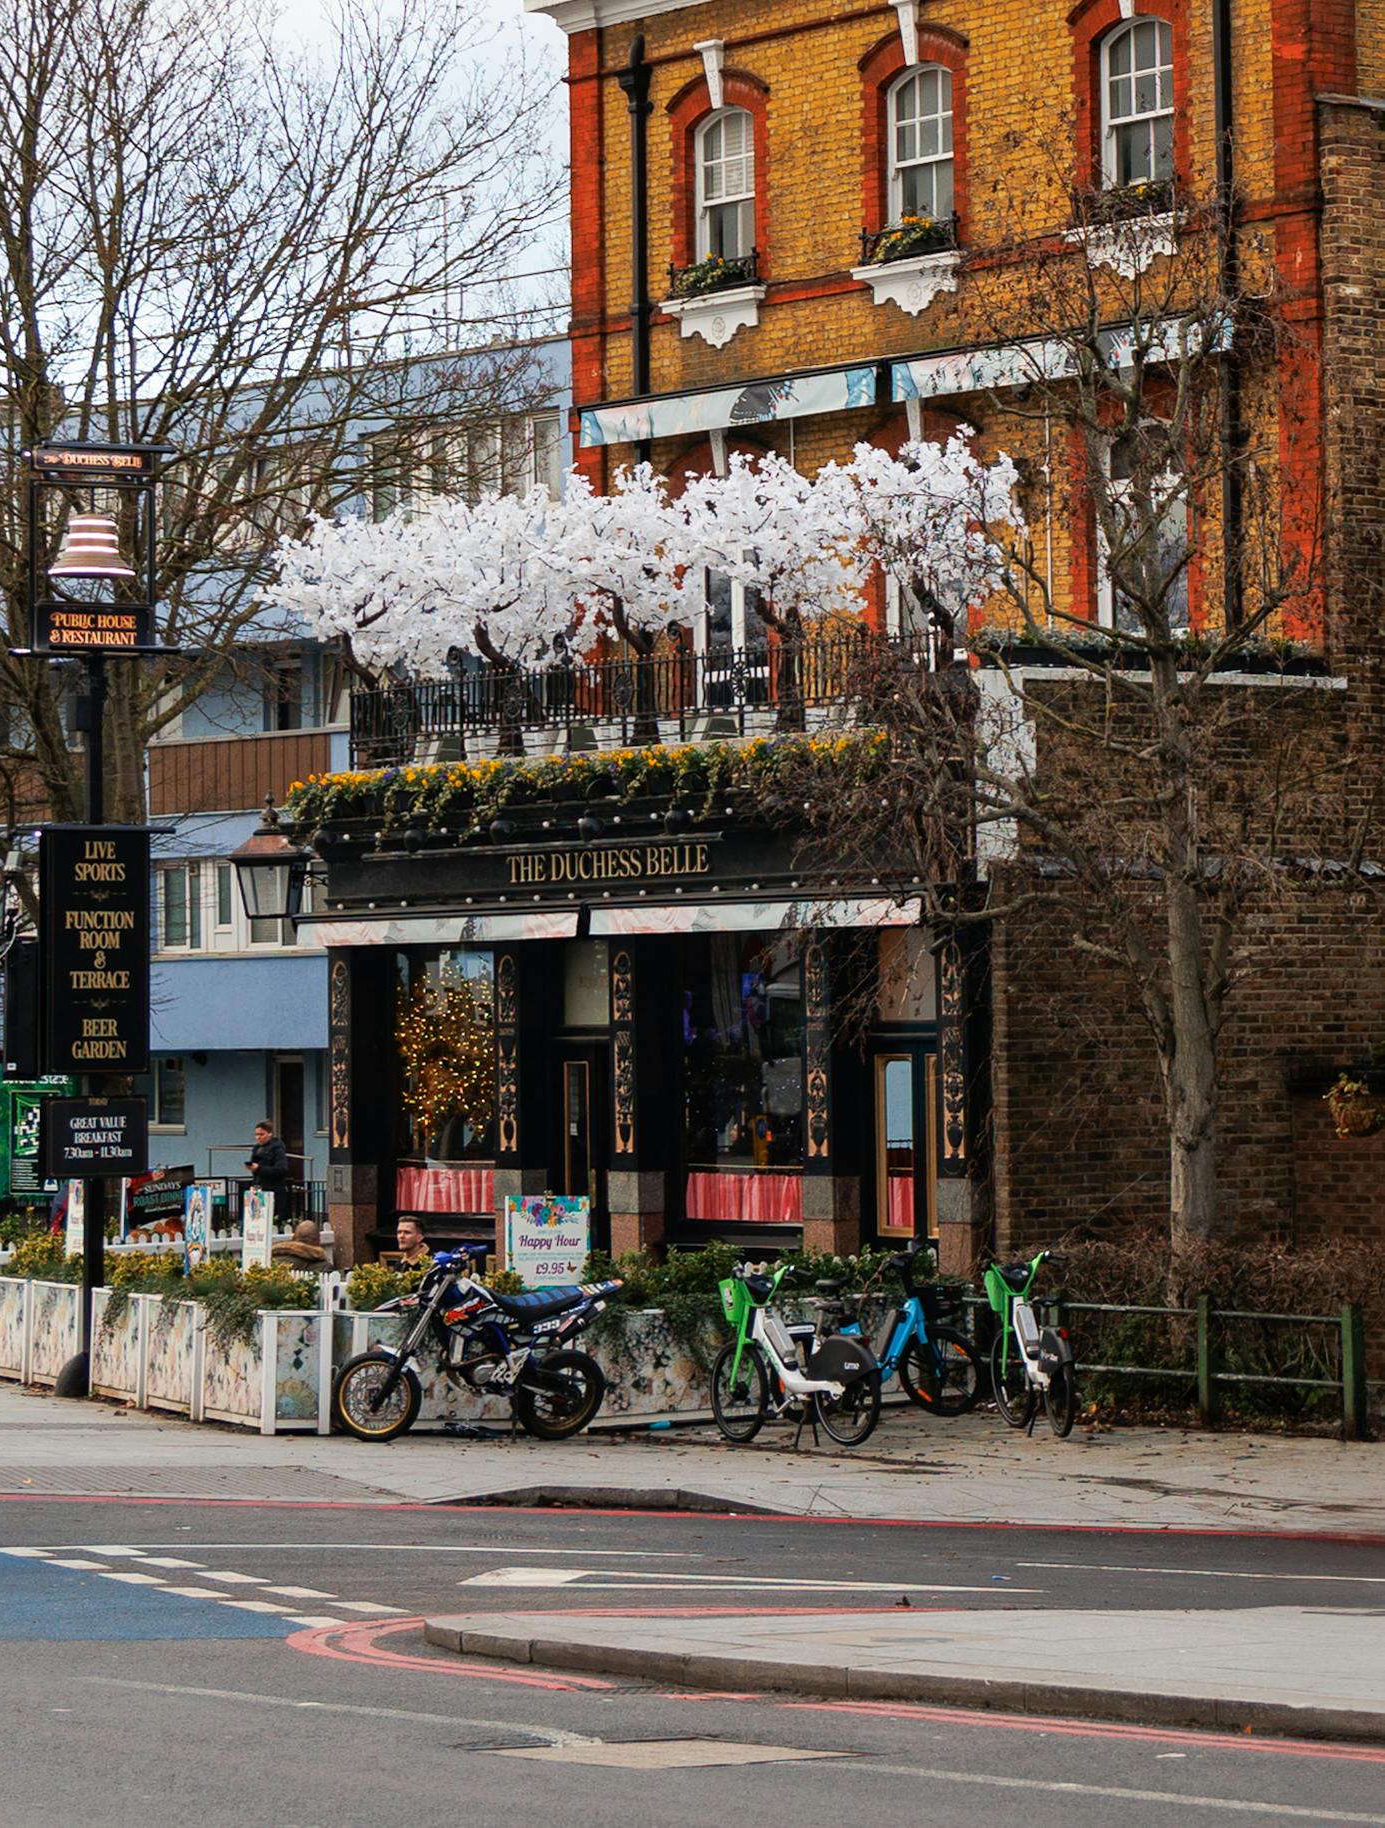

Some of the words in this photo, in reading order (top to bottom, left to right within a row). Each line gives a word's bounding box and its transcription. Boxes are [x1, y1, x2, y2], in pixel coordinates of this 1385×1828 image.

[60, 452, 110, 466] DUCHESS
[50, 612, 95, 628] PUBLIC
[98, 615, 137, 629] HOUSE
[49, 629, 60, 643] &
[61, 629, 137, 645] RESTAURANT
[84, 841, 116, 859] LIVE
[75, 863, 125, 881] SPORTS
[506, 854, 546, 883] THE
[550, 848, 643, 881] DUCHESS
[646, 844, 710, 876] BELLE
[65, 911, 134, 929] FUNCTION
[80, 931, 120, 949] ROOM
[94, 950, 106, 969] &
[70, 971, 130, 989] TERRACE
[82, 1019, 118, 1037] BEER
[72, 1041, 127, 1058] GARDEN
[70, 1116, 98, 1129] GREAT
[99, 1116, 127, 1128] VALUE
[74, 1131, 123, 1144] BREAKFAST
[144, 1180, 182, 1194] SUNDAYS
[133, 1193, 160, 1208] ROAST
[518, 1235, 552, 1250] Happy
[554, 1234, 581, 1247] Hour
[535, 1262, 565, 1275] £9.95
